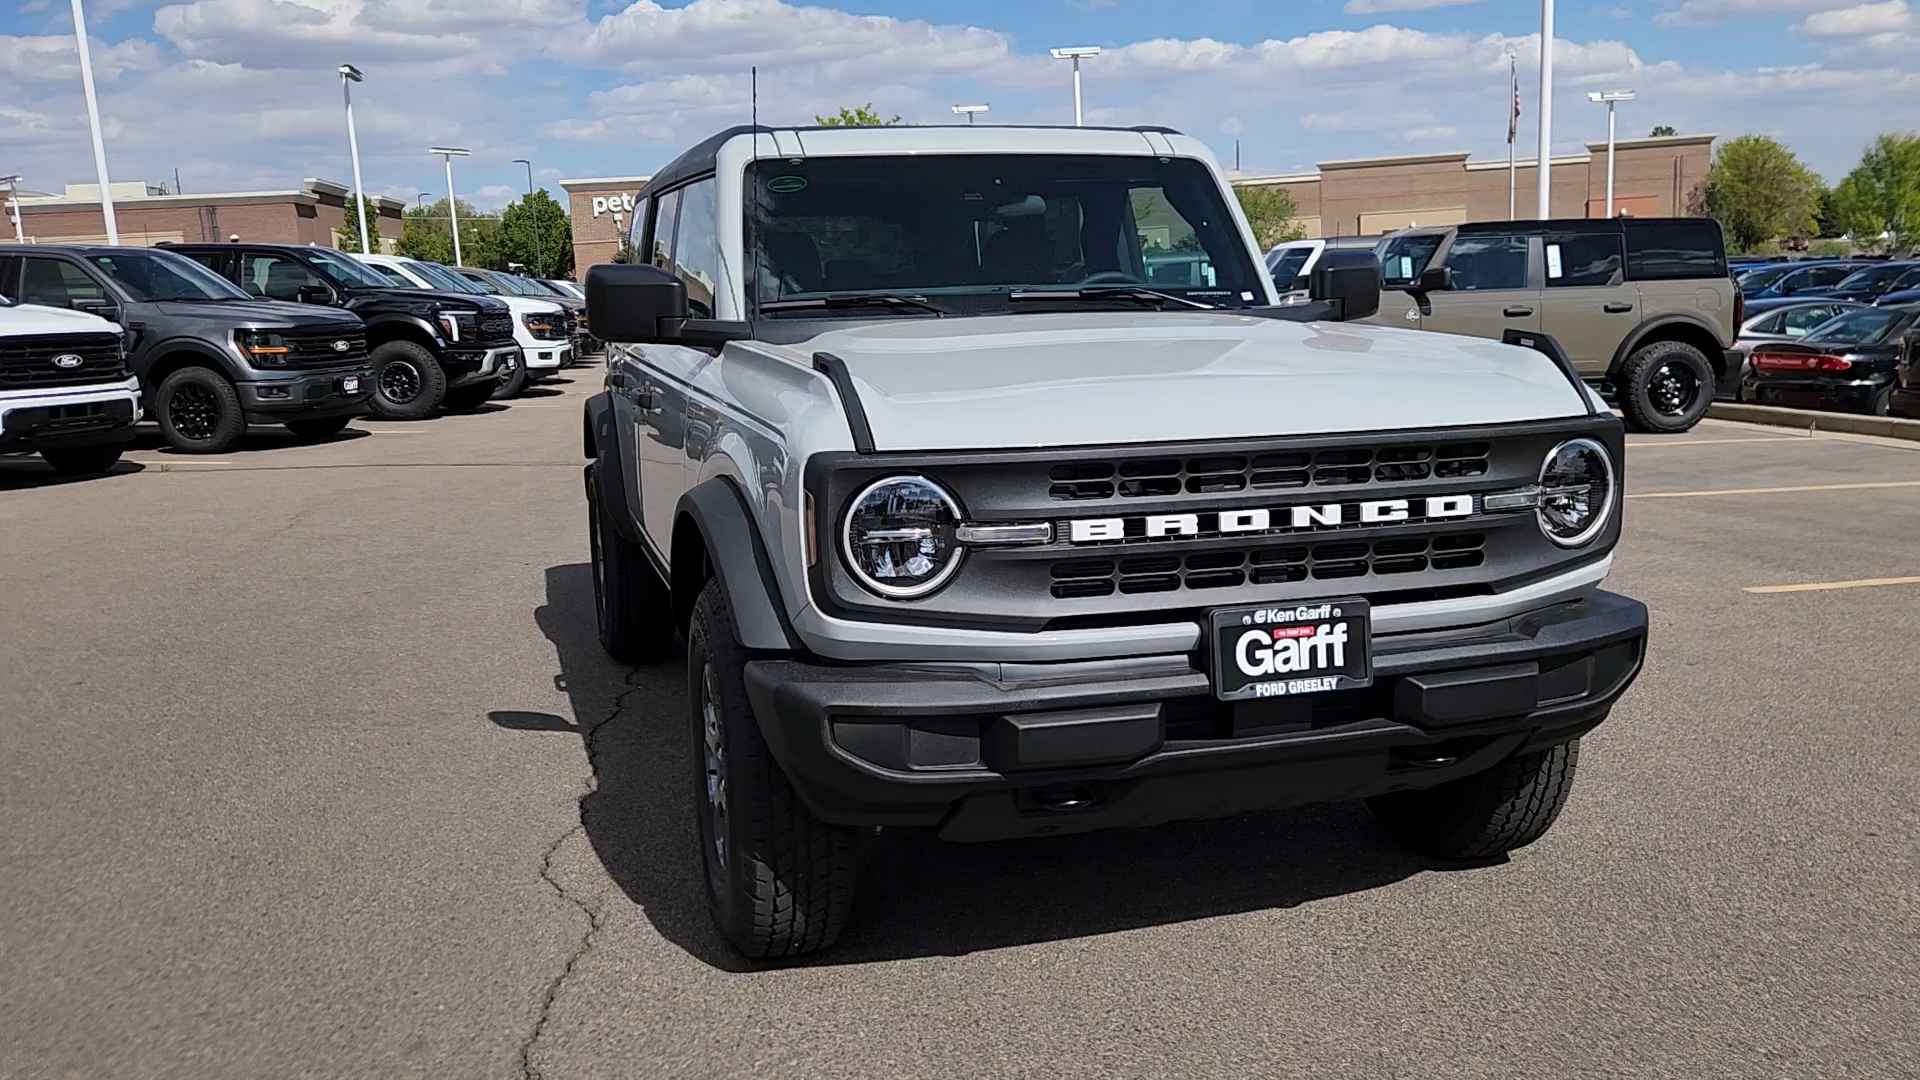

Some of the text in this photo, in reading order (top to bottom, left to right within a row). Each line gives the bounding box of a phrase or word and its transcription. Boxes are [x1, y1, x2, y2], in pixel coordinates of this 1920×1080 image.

[1070, 494, 1473, 542] BRONCO
[1267, 608, 1295, 623] Ken
[1296, 605, 1331, 620] Garff
[1236, 622, 1348, 676] Garff
[1256, 677, 1338, 697] FORD GREELEY
